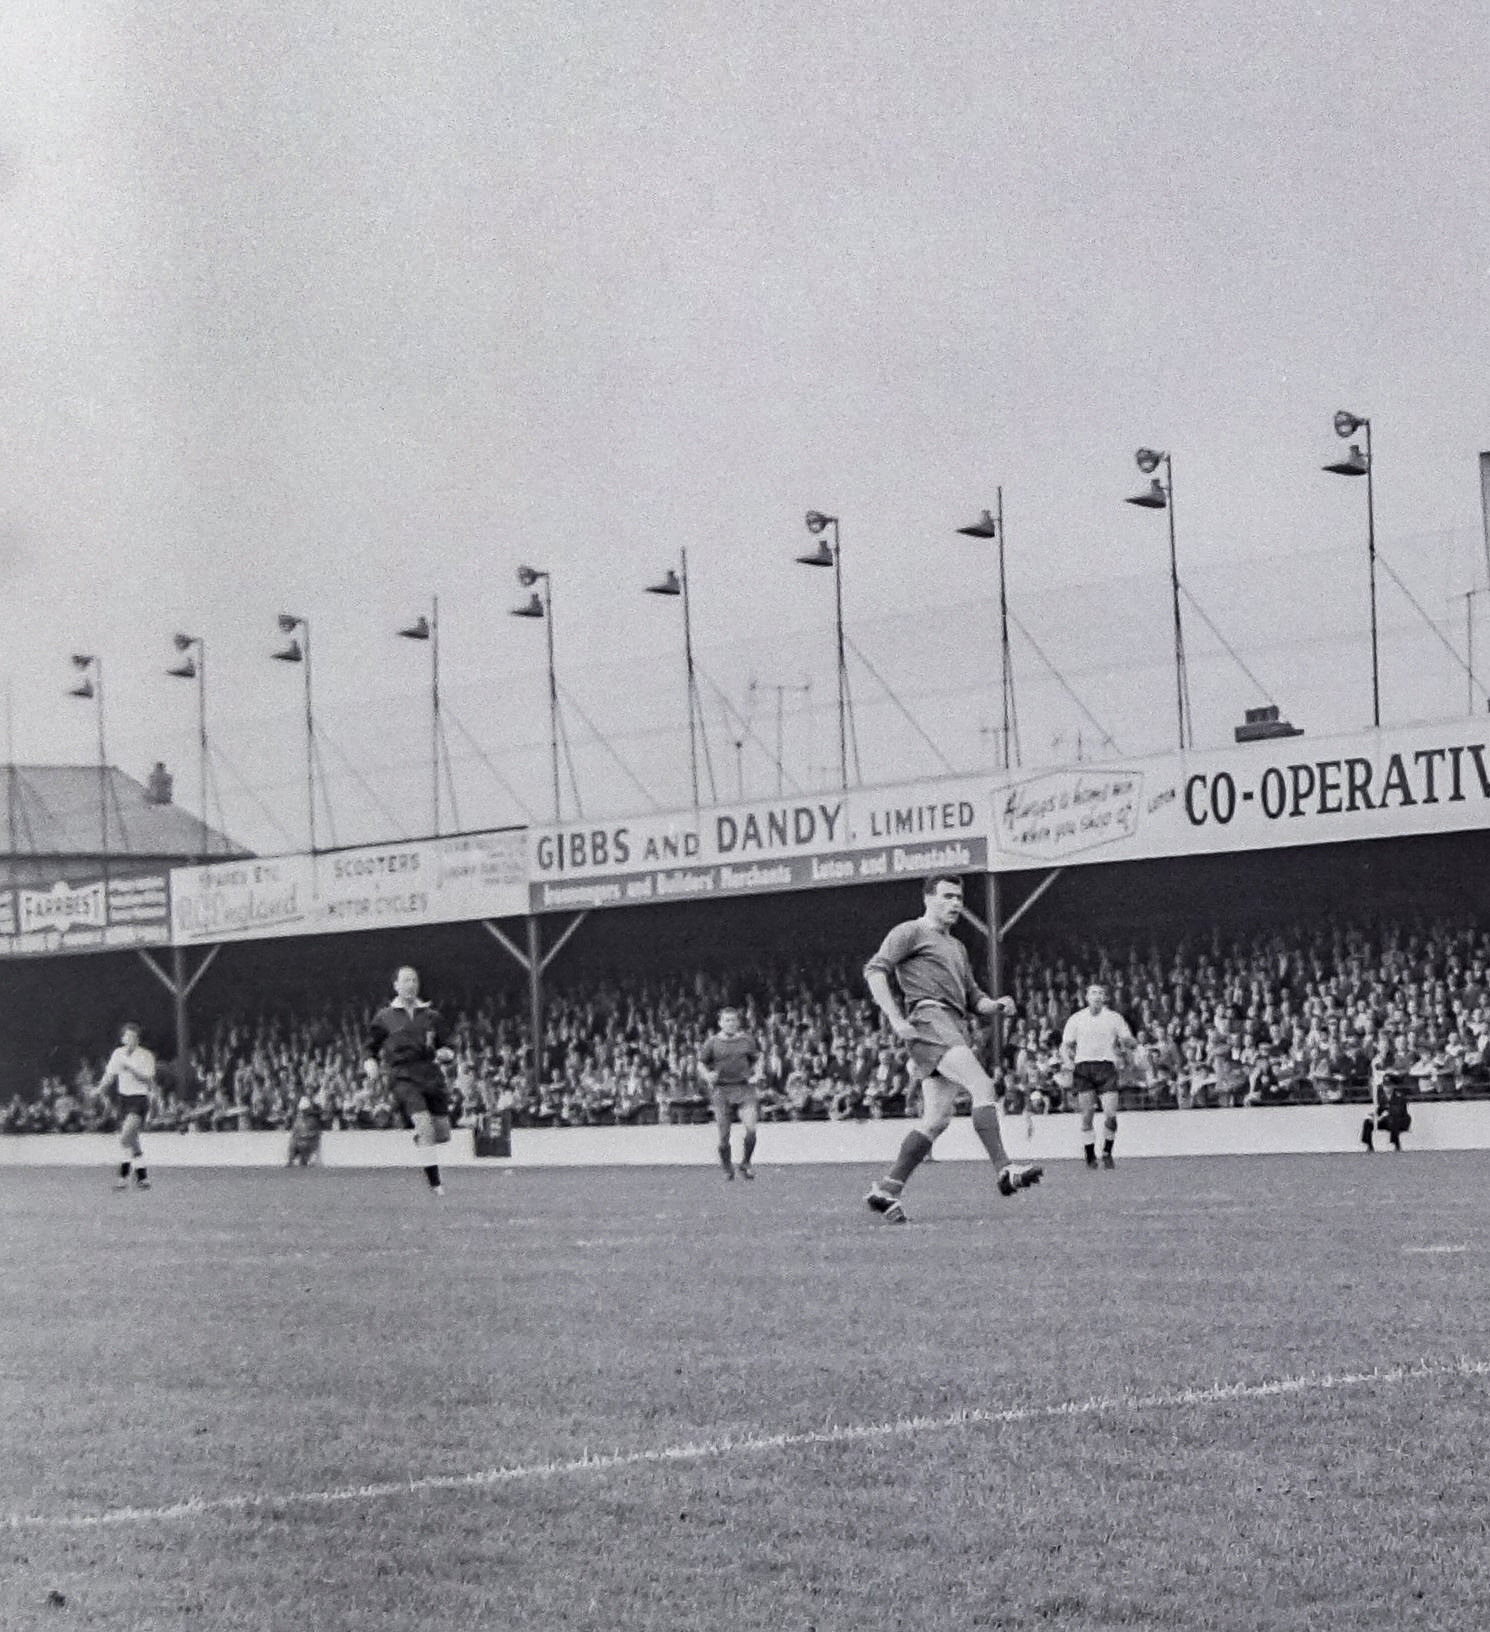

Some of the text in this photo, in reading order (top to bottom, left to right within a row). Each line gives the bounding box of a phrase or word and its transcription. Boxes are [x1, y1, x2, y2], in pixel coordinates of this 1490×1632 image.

[537, 828, 630, 871] GIBBS
[644, 833, 699, 860] AND
[870, 801, 975, 836] LIMITED
[335, 852, 419, 878] SCOOTERS
[812, 857, 854, 880] Luton
